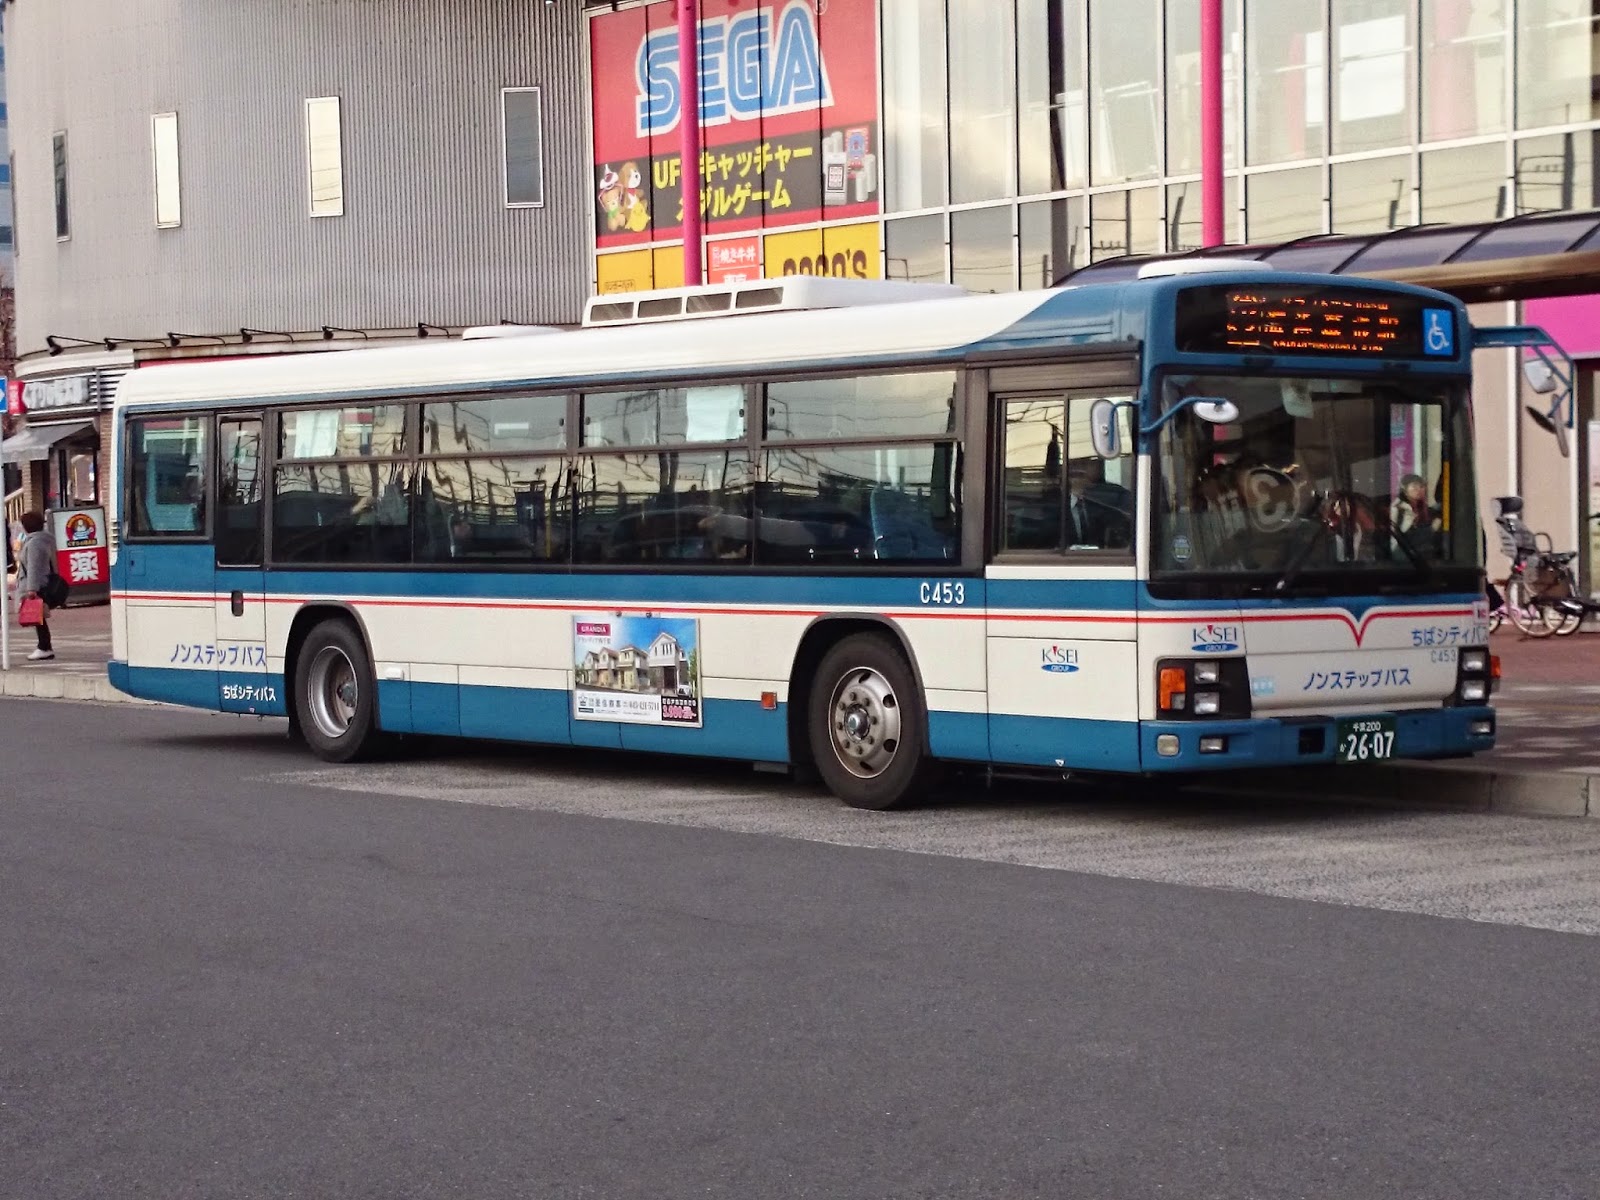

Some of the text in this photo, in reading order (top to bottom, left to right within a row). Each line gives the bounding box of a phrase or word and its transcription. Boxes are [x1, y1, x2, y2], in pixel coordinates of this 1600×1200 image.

[635, 2, 835, 138] SEGA
[653, 143, 813, 190] UFキャッチャー
[676, 178, 792, 221] ダルゲーム
[69, 551, 99, 582] 薬
[920, 582, 965, 605] C453
[170, 643, 267, 667] ノンステップバス
[1303, 668, 1411, 690] ノンステップバス
[222, 684, 277, 702] ちばシティバス
